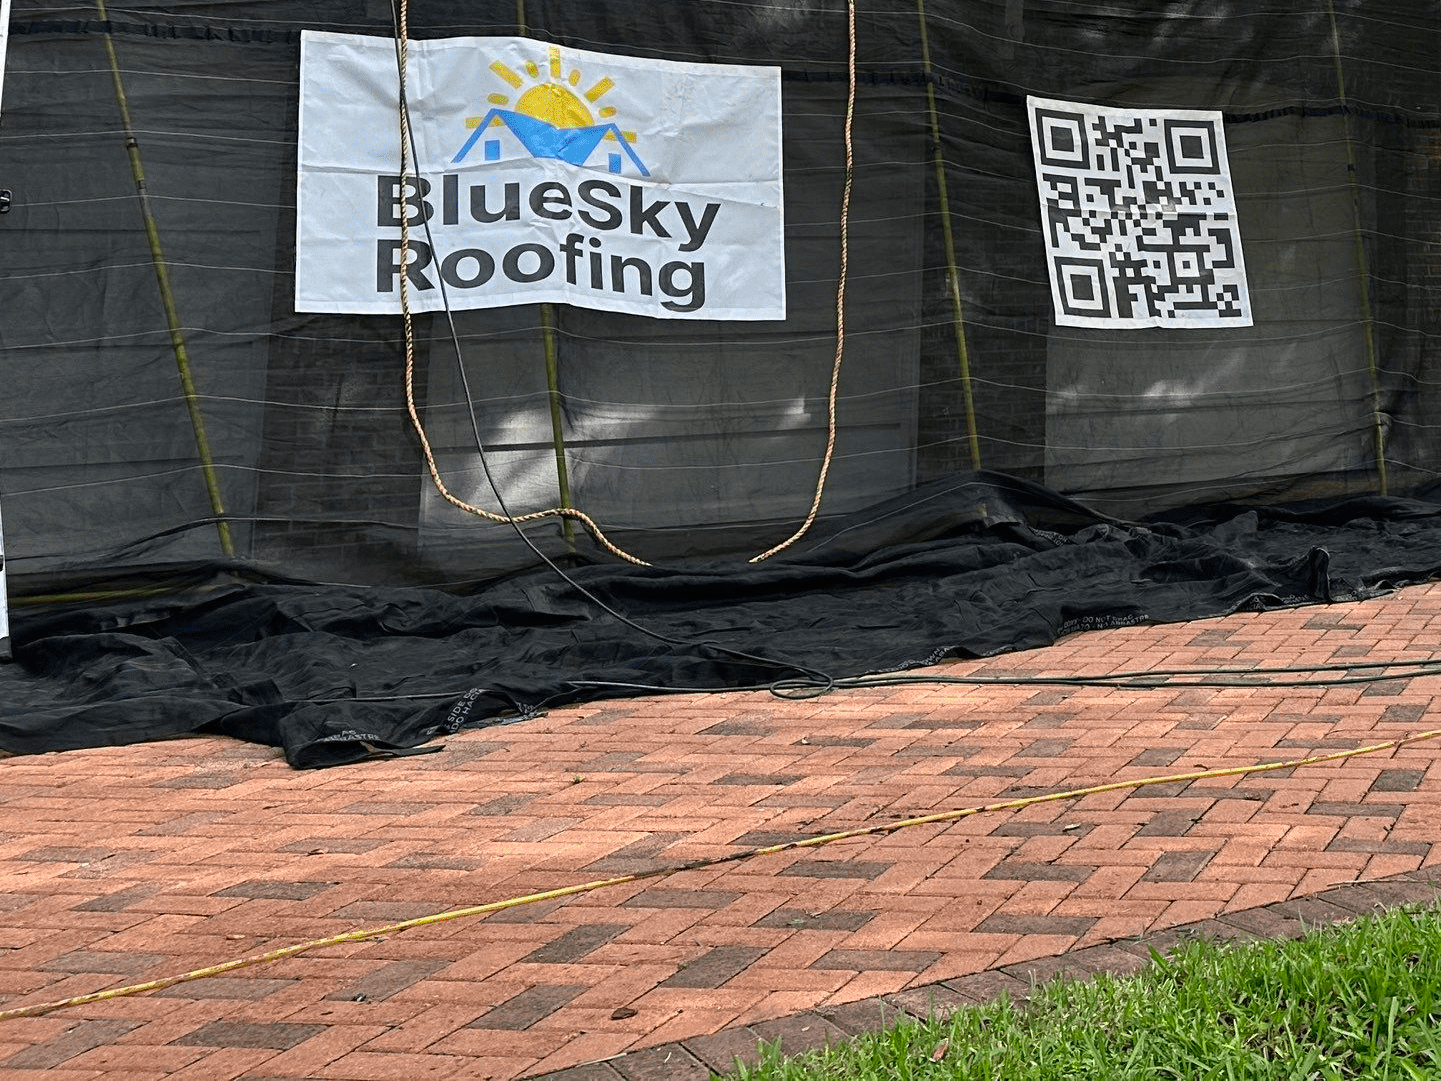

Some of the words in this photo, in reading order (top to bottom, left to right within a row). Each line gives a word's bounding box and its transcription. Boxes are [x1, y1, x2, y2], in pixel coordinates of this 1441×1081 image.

[377, 173, 722, 252] BlueSky
[376, 232, 706, 312] Roofing
[1095, 614, 1111, 623] NOT
[447, 701, 466, 722] SIDE
